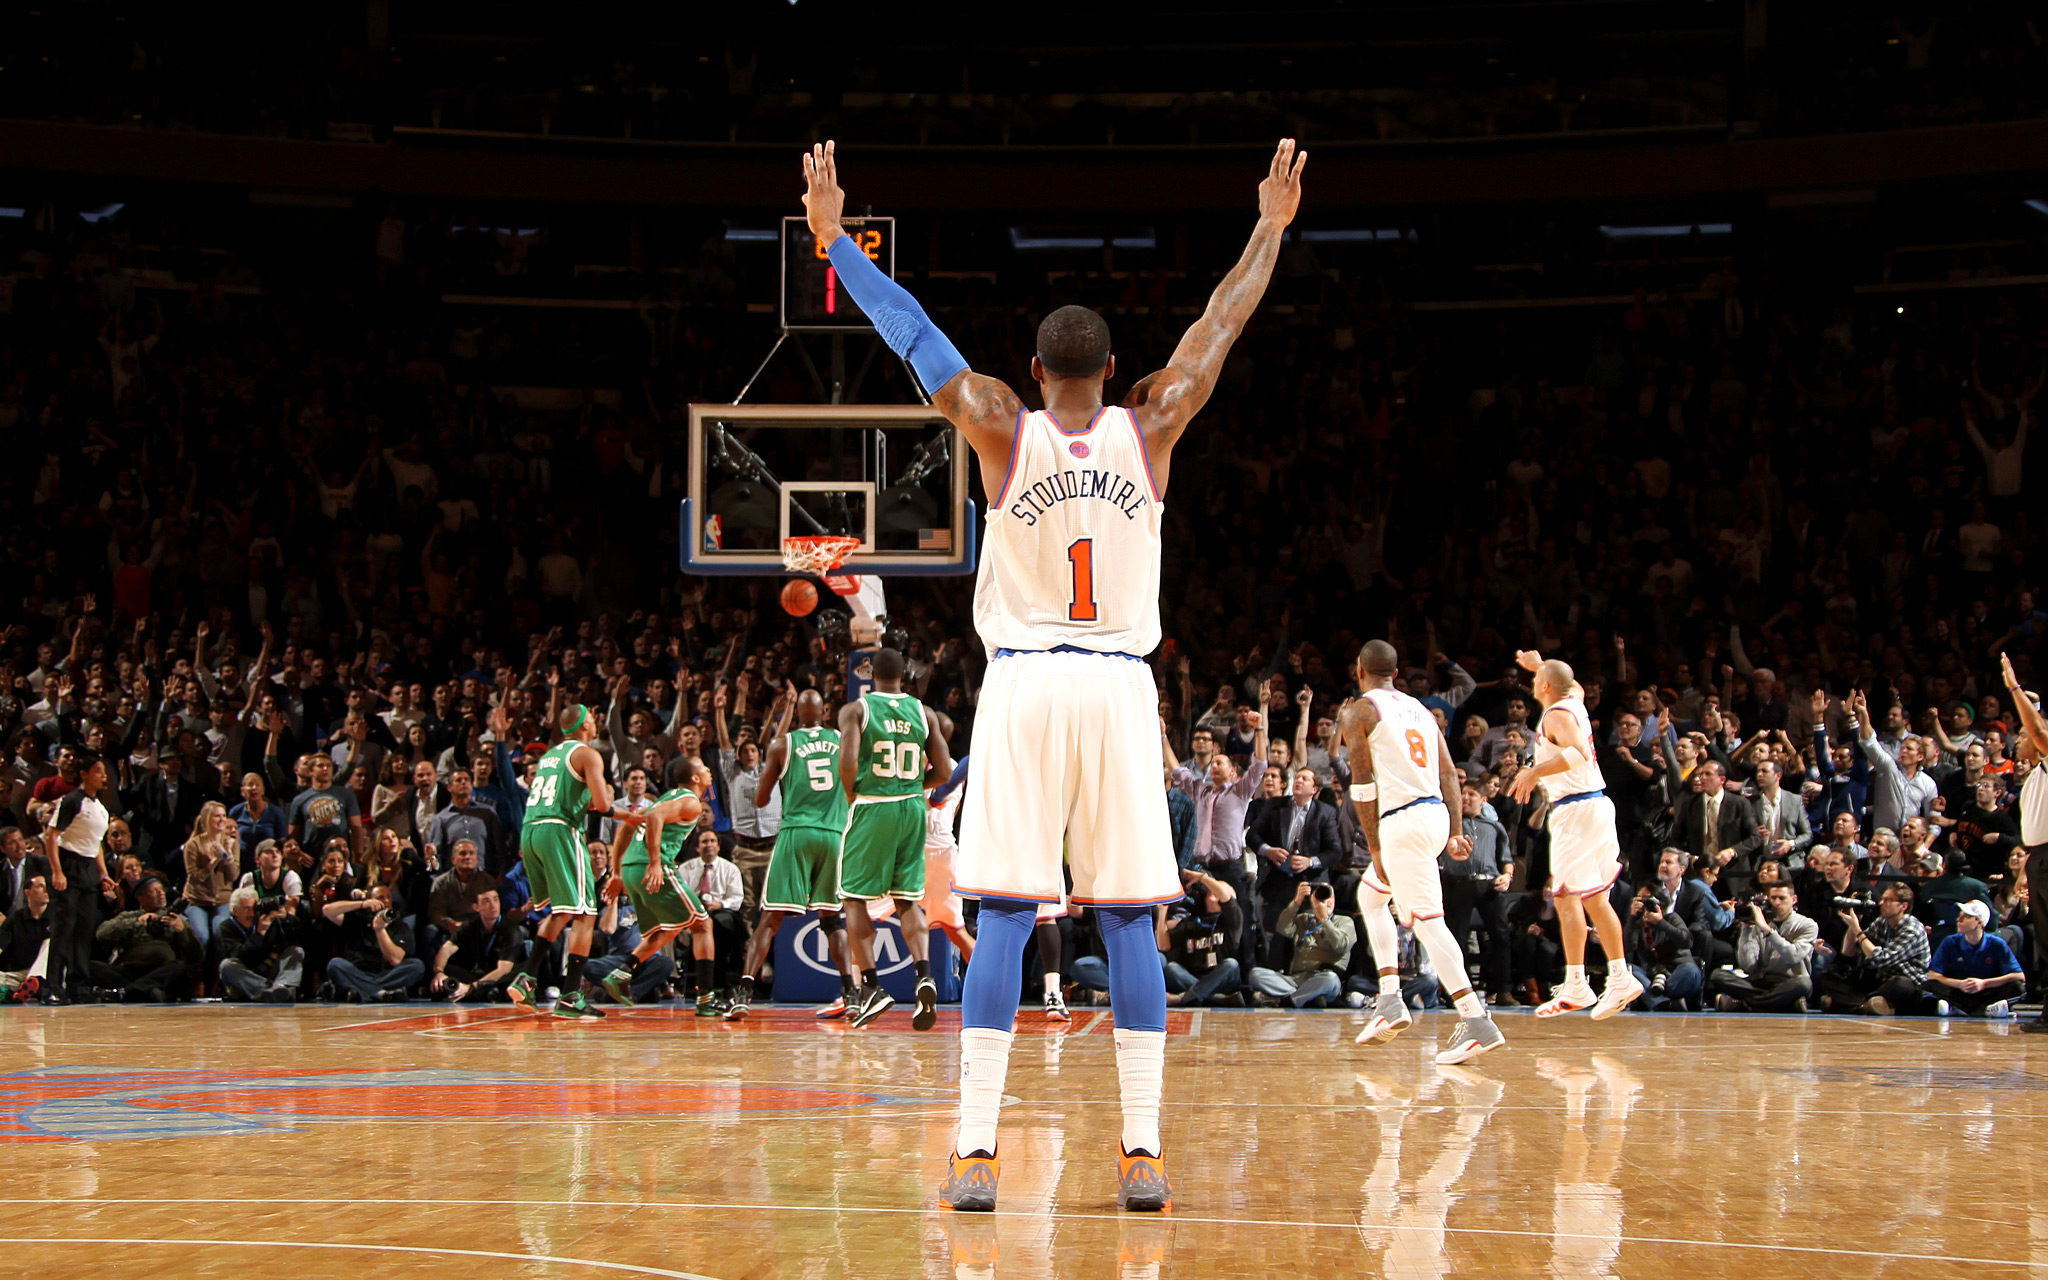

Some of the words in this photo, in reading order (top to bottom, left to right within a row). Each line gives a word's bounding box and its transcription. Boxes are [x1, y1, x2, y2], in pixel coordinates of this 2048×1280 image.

[1011, 470, 1147, 526] STOUDEMIRE
[1067, 538, 1098, 622] 1
[883, 720, 912, 735] BASS
[871, 740, 921, 780] 30
[1405, 728, 1428, 768] 8
[526, 775, 558, 807] 34
[806, 757, 834, 791] 5
